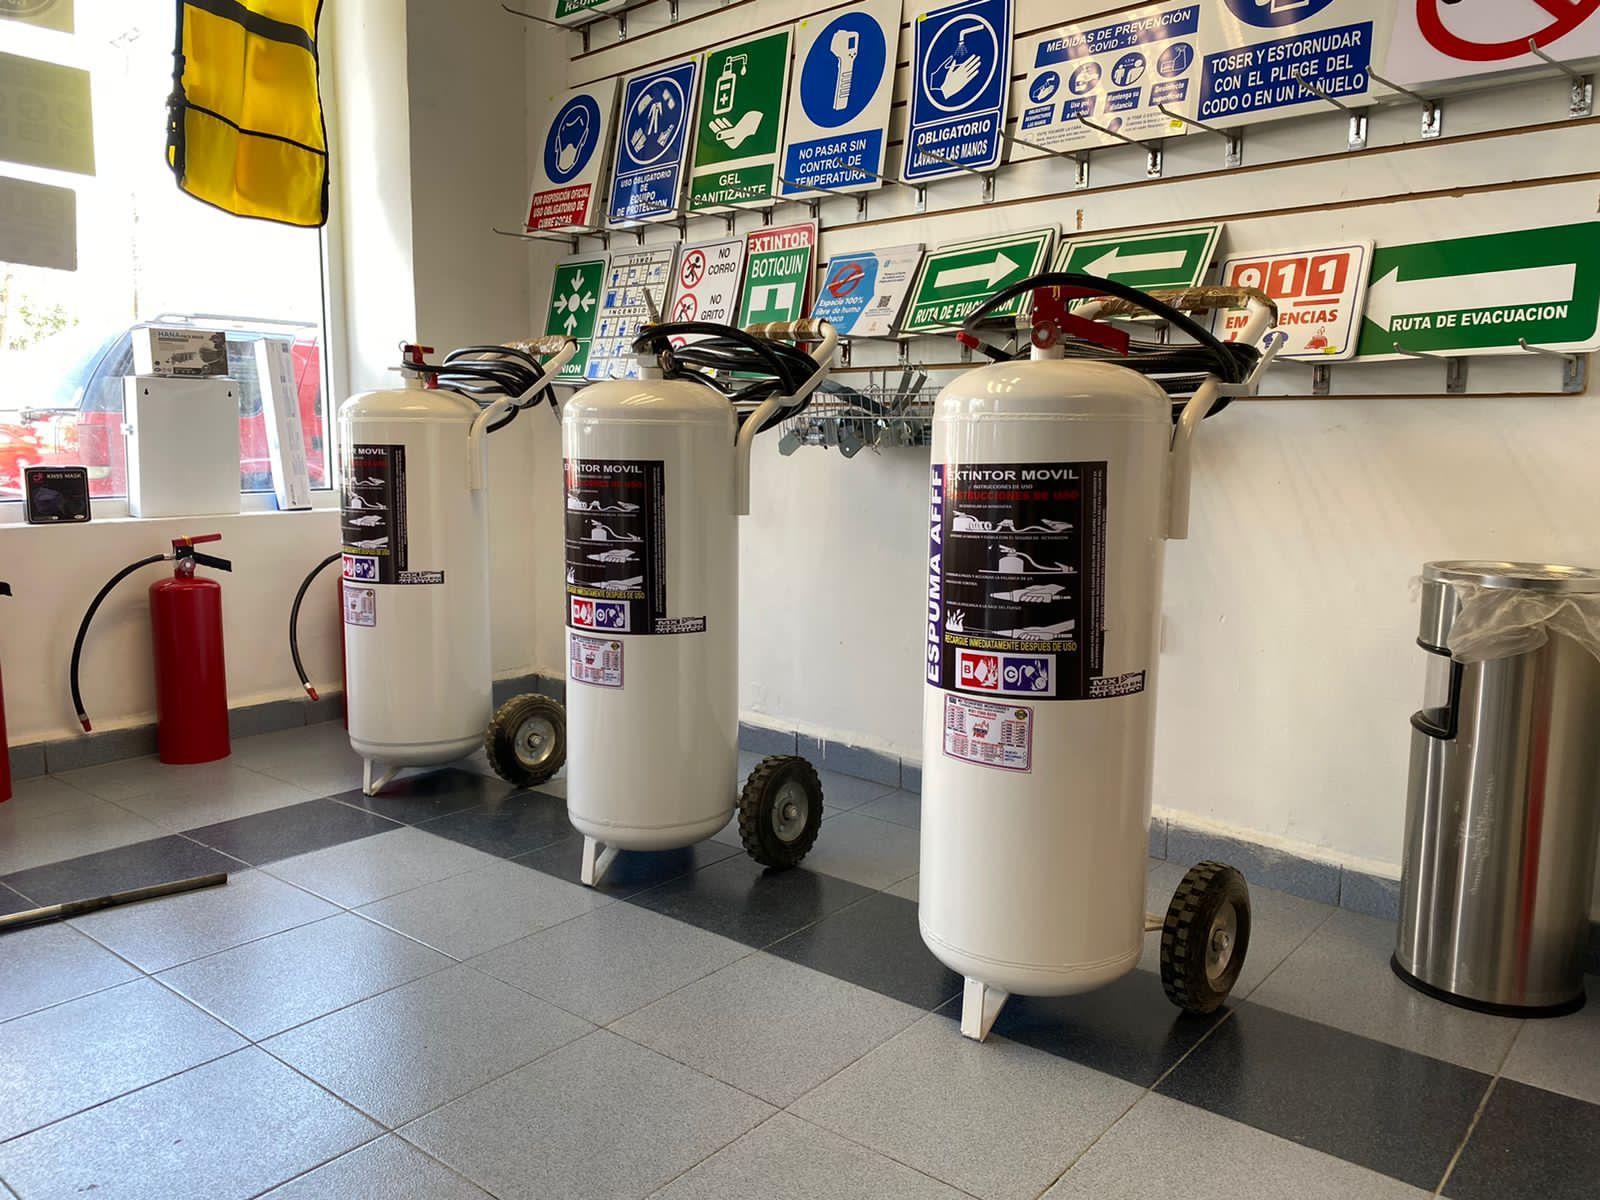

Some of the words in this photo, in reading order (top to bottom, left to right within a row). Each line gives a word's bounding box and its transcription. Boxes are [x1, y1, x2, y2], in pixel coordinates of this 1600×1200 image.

[1047, 35, 1094, 53] MEDIDAS
[1097, 28, 1113, 41] DE
[1115, 10, 1191, 37] PREVENCIÓN
[1088, 40, 1118, 54] COVID
[1127, 35, 1138, 46] 19
[1211, 51, 1253, 75] TOSER
[1256, 49, 1267, 67] Y
[1268, 30, 1362, 64] ESTORNUDAR
[1214, 73, 1242, 93] CON
[1247, 70, 1265, 88] EL
[1270, 60, 1319, 84] PLIEGE
[1326, 55, 1353, 74] DEL
[1202, 96, 1239, 116] CODO
[1241, 94, 1252, 109] O
[1255, 91, 1274, 107] EN
[1276, 86, 1296, 103] UN
[1298, 72, 1364, 100] PAÑUELO
[917, 119, 991, 146] OBLIGATORIO
[799, 145, 814, 160] NO
[815, 141, 848, 157] PASAR
[849, 138, 867, 152] SIN
[945, 145, 960, 161] LAS
[960, 140, 988, 159] MANOS
[847, 154, 862, 167] DE
[620, 178, 633, 188] USO
[633, 170, 672, 185] OBLIGATORIO
[719, 172, 742, 186] GEL
[795, 167, 866, 186] TEMPERATURA
[639, 183, 649, 192] DE
[630, 191, 656, 205] EQUIPO
[533, 207, 544, 218] USO
[544, 202, 576, 216] OBLIGATORIO
[576, 200, 585, 211] DE
[616, 207, 625, 217] DE
[748, 231, 809, 254] EXTINTOR
[718, 247, 731, 259] NO
[707, 262, 736, 275] CORRO
[751, 254, 805, 278] BOTIQUIN
[1237, 259, 1339, 295] 911
[709, 293, 722, 305] NO
[701, 308, 725, 321] GRITO
[914, 305, 940, 324] RUTA
[939, 304, 953, 320] DE
[1225, 308, 1339, 330] EMENCIAS
[1391, 315, 1432, 333] RUTA
[1435, 312, 1457, 330] DE
[1459, 304, 1569, 328] EVACUACION
[358, 447, 388, 456] MOVIL
[603, 464, 643, 474] MOVIL
[1021, 468, 1080, 481] MOVIL
[930, 471, 943, 545] AFFF
[927, 554, 942, 685] ESPUMA
[969, 637, 1019, 650] INMEDIATAMENTE
[1020, 640, 1052, 651] DESPUES
[1052, 641, 1062, 651] DE
[1063, 642, 1077, 652] USO
[963, 661, 972, 674] B
